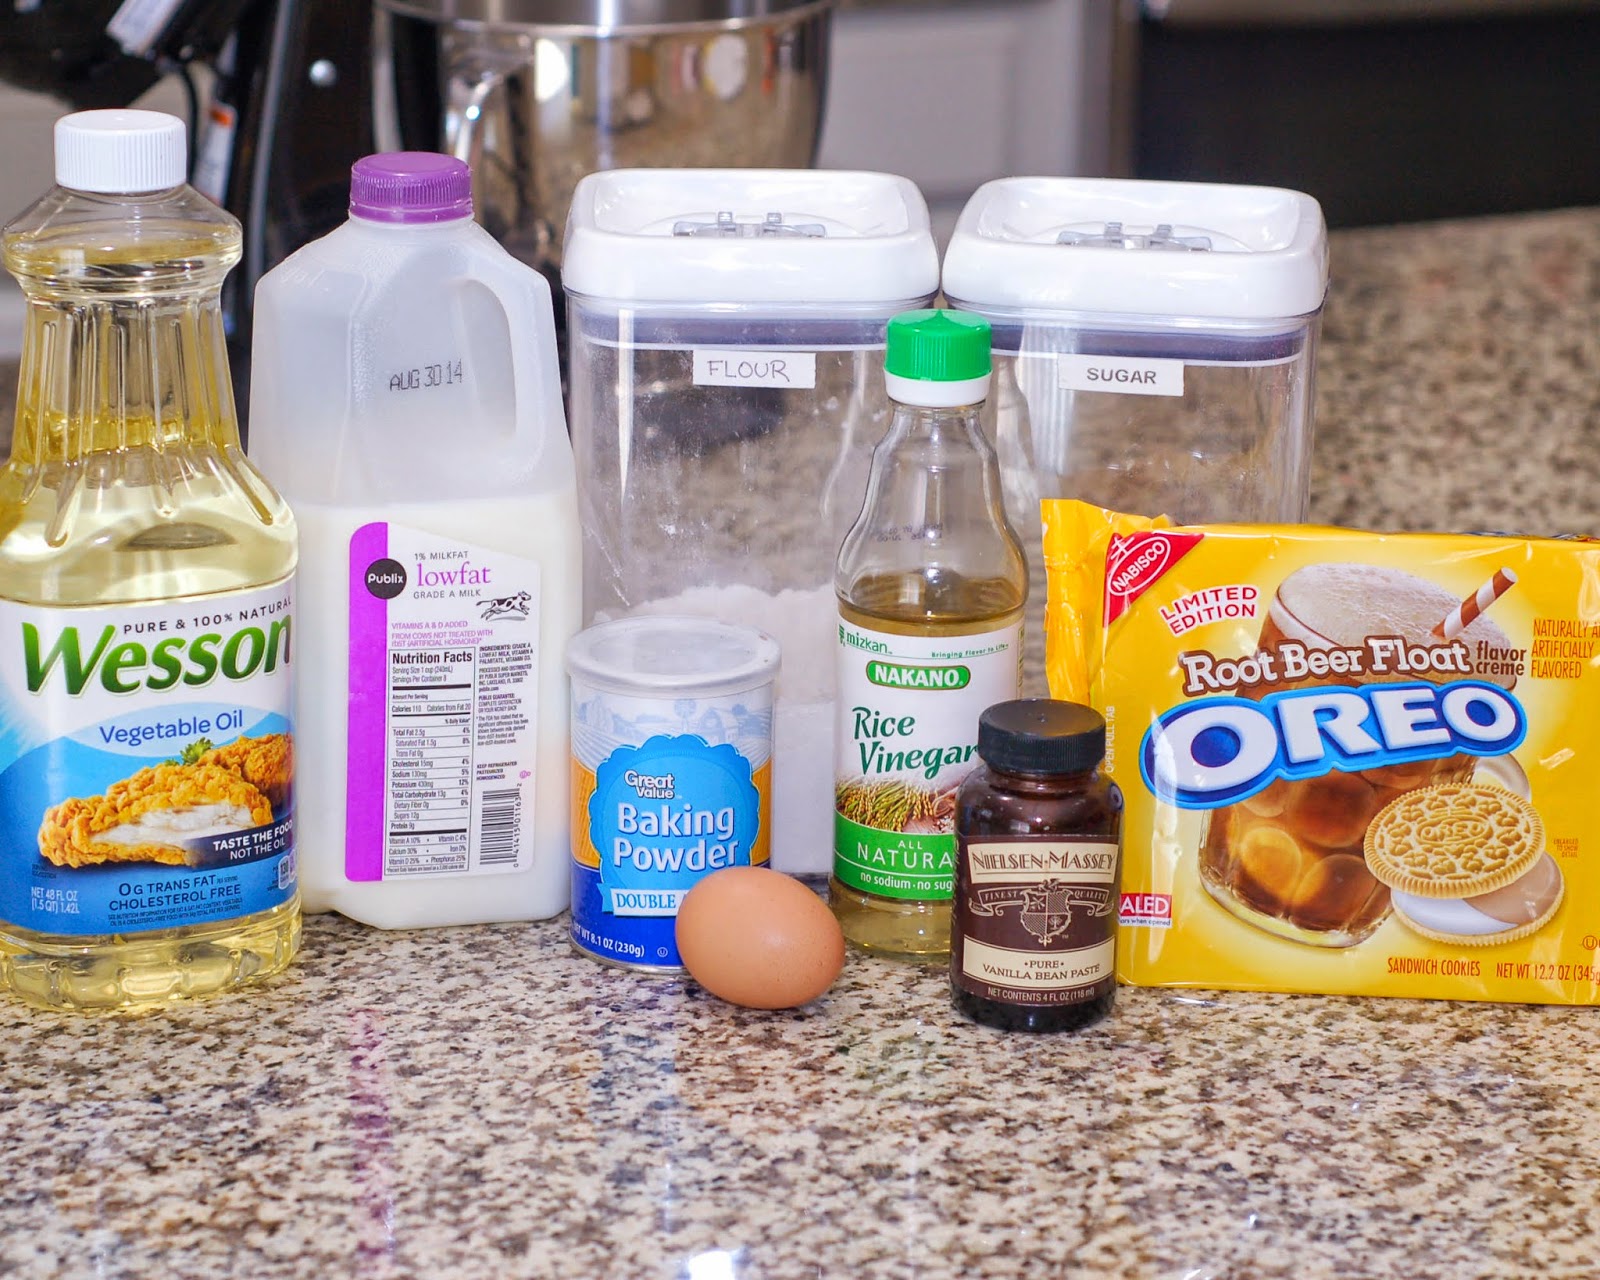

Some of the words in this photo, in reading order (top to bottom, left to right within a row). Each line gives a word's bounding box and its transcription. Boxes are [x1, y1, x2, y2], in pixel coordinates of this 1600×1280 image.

[389, 369, 420, 391] AUG
[424, 363, 442, 387] 30
[446, 358, 463, 384] 14
[707, 359, 790, 382] FLOUR
[1086, 367, 1157, 385] SUGAR
[414, 553, 426, 561] 1%
[430, 551, 469, 561] MILKFAT
[1112, 541, 1165, 592] NABISCO
[367, 573, 404, 584] Publix
[416, 561, 491, 586] lowfat
[413, 591, 445, 600] GRADE
[449, 590, 455, 598] A
[459, 589, 481, 598] MILK
[1160, 587, 1257, 620] LIMITED
[124, 620, 168, 635] PURE
[176, 619, 186, 630] &
[193, 613, 233, 628] 100%
[391, 622, 423, 630] VITAMINS
[444, 620, 468, 629] ADDED
[1169, 604, 1256, 634] EDITION
[1533, 619, 1589, 638] NATURALLY
[391, 632, 411, 640] FROM
[412, 631, 432, 640] COWS
[449, 630, 476, 638] TREATED
[477, 629, 493, 637] WITH
[846, 632, 888, 654] mizkan
[22, 614, 291, 696] Wesson
[392, 652, 440, 665] Nutrition
[443, 651, 473, 663] Facts
[931, 651, 963, 659] Bringing
[1476, 641, 1527, 662] flavor
[1531, 640, 1594, 658] ARTIFICIALLY
[874, 664, 960, 687] NAKANO
[1183, 652, 1277, 693] Root
[1279, 643, 1363, 679] Beer
[1367, 637, 1471, 673] Float
[1476, 661, 1525, 677] creme
[1531, 660, 1582, 679] FLAVORED
[852, 706, 916, 740] Rice
[1105, 705, 1115, 723] TAB
[100, 716, 211, 747] Vegetable
[215, 710, 243, 730] Oil
[1105, 723, 1115, 748] PULL
[1154, 686, 1517, 793] OREO
[859, 740, 979, 780] Vinegar
[1104, 749, 1114, 773] OPEN
[624, 769, 675, 789] Great
[404, 790, 436, 799] Carbohydrate
[636, 785, 675, 800] Value
[617, 802, 735, 841] Baking
[213, 836, 250, 851] TASTE
[252, 830, 272, 843] THE
[274, 819, 293, 838] FOOD
[898, 840, 923, 850] ALL
[230, 847, 252, 860] NOT
[254, 842, 272, 855] THE
[273, 837, 286, 849] OIL
[613, 836, 740, 872] Powder
[857, 842, 953, 869] NATURA
[147, 879, 190, 894] TRANS
[193, 874, 216, 888] FAT
[860, 871, 872, 883] no
[873, 875, 911, 889] sodium
[917, 881, 931, 891] no
[934, 880, 953, 892] sug
[31, 886, 44, 899] NET
[45, 889, 55, 900] 48
[56, 889, 65, 901] FL
[66, 890, 78, 902] OZ
[109, 890, 207, 911] CHOLESTEROL
[211, 884, 241, 899] FREE
[616, 892, 676, 909] DOUBLE
[985, 891, 1018, 902] FINEST
[1074, 891, 1107, 900] QUALITY
[1120, 896, 1169, 914] ALED
[581, 928, 590, 941] WT
[590, 933, 601, 946] 8.1
[602, 937, 614, 950] OZ
[614, 940, 645, 958] (230g)
[983, 964, 1032, 980] VANILLA
[1035, 971, 1068, 980] BEAN
[1071, 964, 1100, 978] PASTE
[1029, 960, 1060, 968] PURE
[1387, 957, 1438, 975] SANDWICH
[1441, 959, 1480, 977] COOKIES
[1496, 962, 1514, 978] NET
[1516, 963, 1531, 979] WT
[1534, 964, 1554, 980] 12.2
[1557, 964, 1570, 981] OZ
[987, 987, 1001, 997] NET
[1002, 988, 1042, 1001] CONTENTS
[1050, 992, 1058, 1001] FL
[1060, 991, 1069, 1001] OZ
